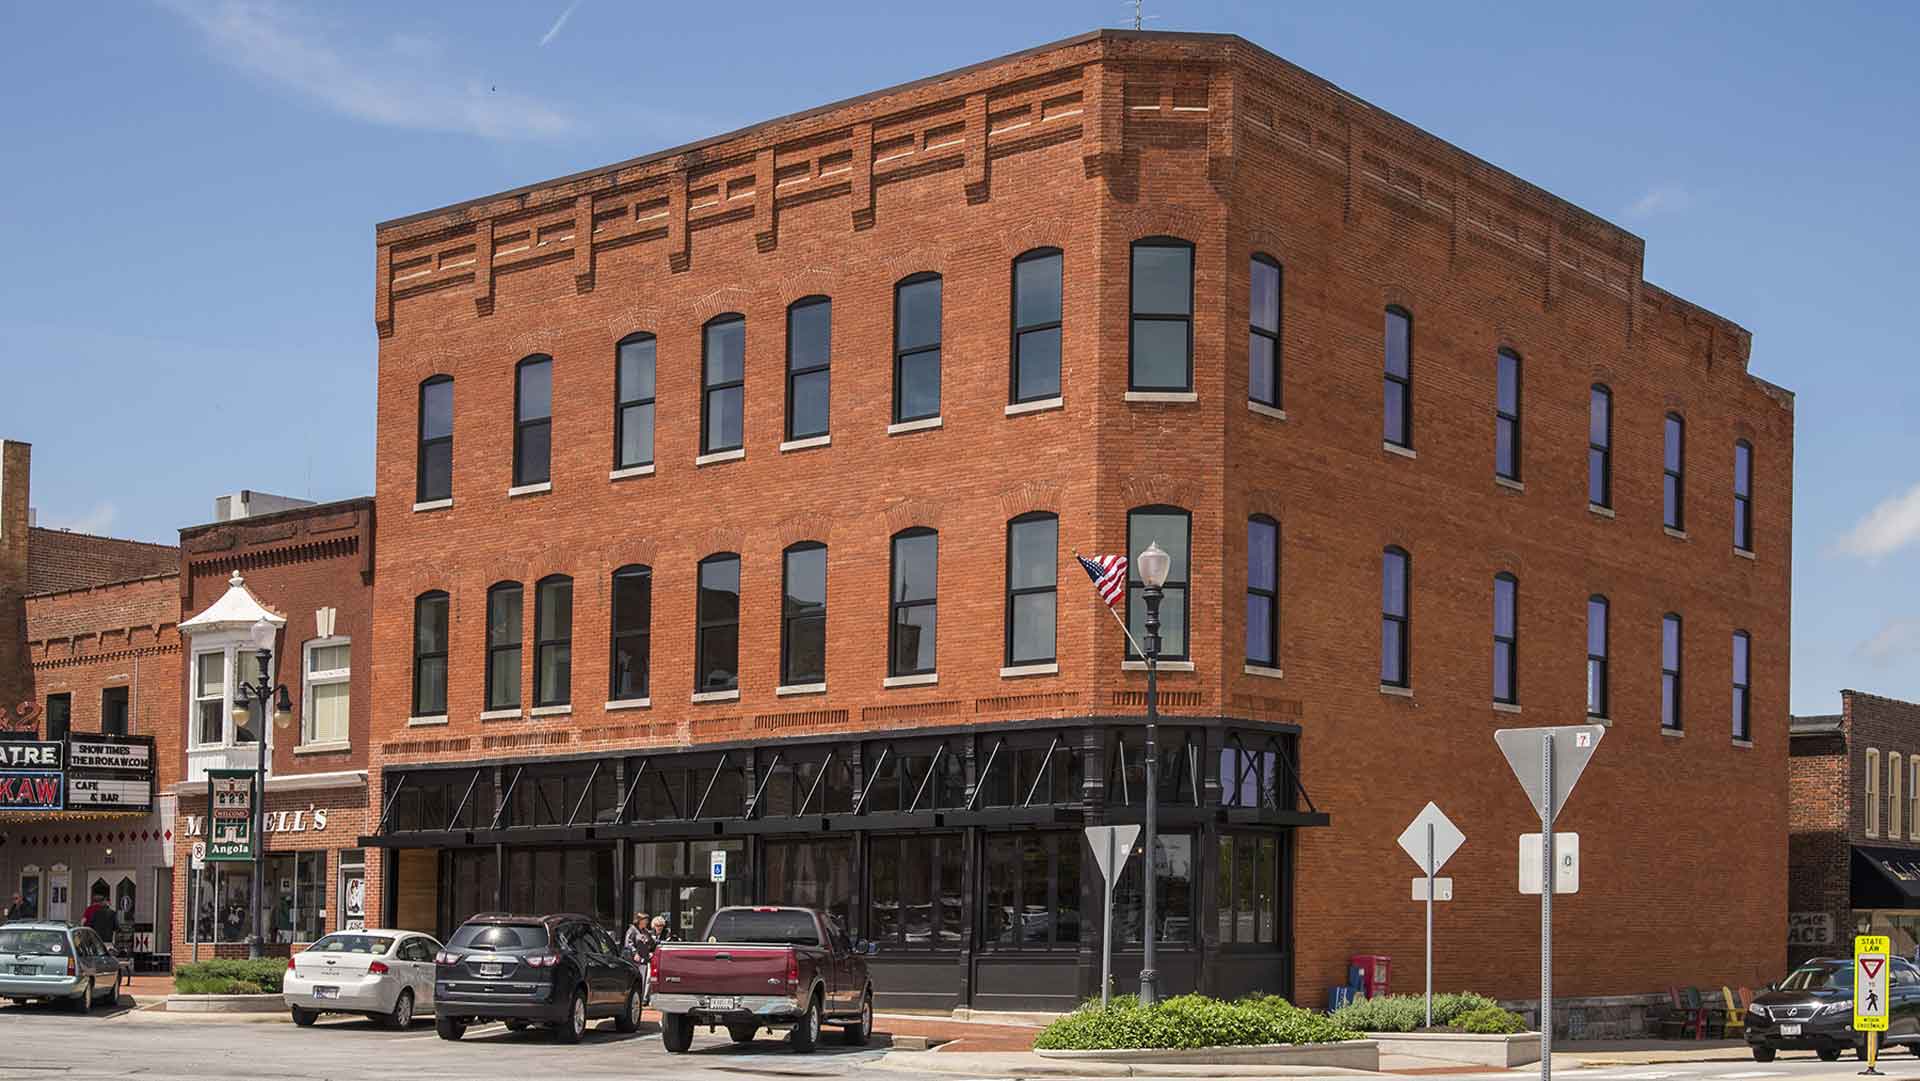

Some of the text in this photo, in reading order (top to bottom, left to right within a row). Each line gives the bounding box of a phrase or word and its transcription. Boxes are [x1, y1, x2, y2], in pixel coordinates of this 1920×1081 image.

[79, 745, 131, 755] SHOW TIMES
[0, 777, 58, 804] KAW
[75, 781, 98, 791] CAFE
[100, 793, 119, 802] BAR
[184, 804, 328, 836] MELL'S
[211, 844, 249, 855] Angola
[1861, 937, 1883, 945] STATE
[1864, 945, 1880, 953] LAW
